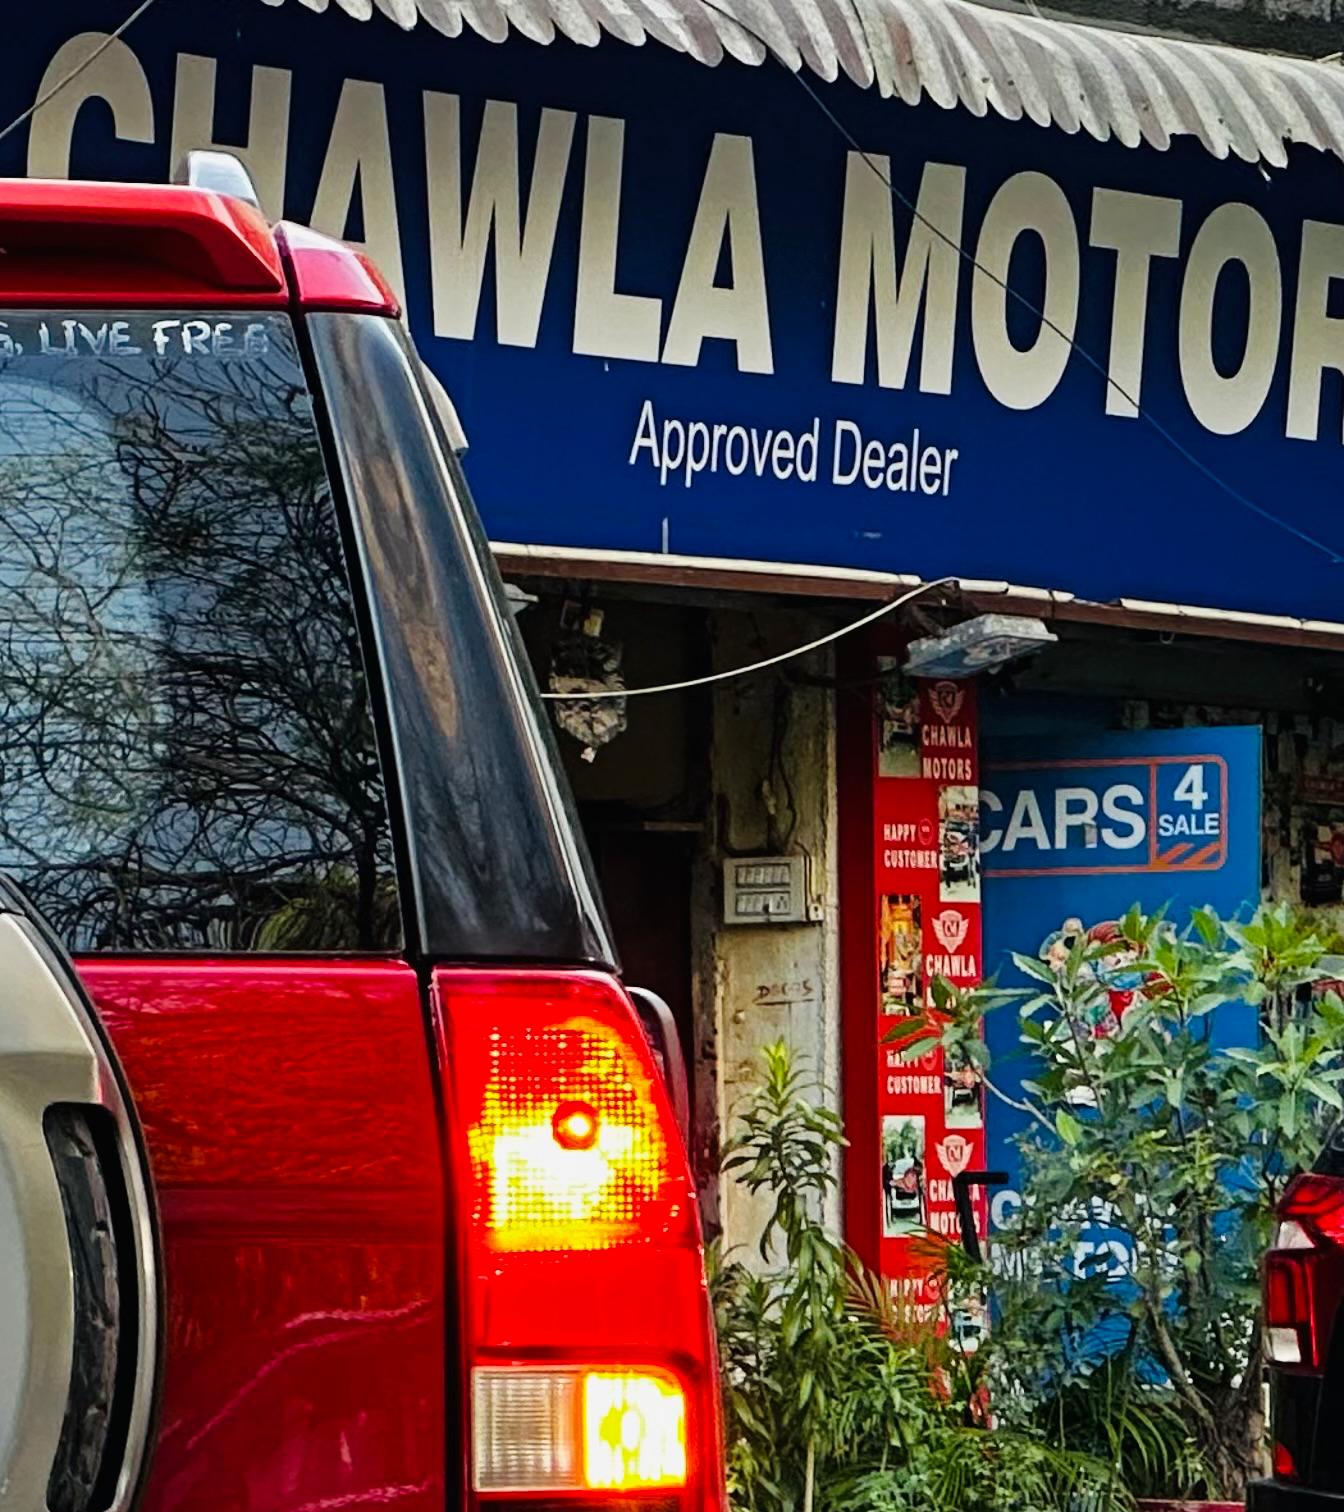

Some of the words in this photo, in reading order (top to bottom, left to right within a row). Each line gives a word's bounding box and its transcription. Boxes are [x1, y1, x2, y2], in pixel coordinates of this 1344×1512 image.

[832, 150, 1344, 442] MOTOR
[37, 319, 142, 356] LIVE
[151, 319, 269, 357] FREE
[629, 400, 820, 487] Approved
[833, 420, 959, 496] Dealer
[922, 724, 972, 748] CHAWLA
[923, 757, 972, 781] MOTORS
[1174, 764, 1208, 810] 4
[883, 823, 916, 843] HAPPY
[1158, 813, 1220, 837] SALE
[883, 849, 938, 869] CUSTOMER
[925, 954, 977, 977] CHAWLA
[887, 1075, 942, 1095] CUSTOMER
[929, 1179, 981, 1201] CHAA
